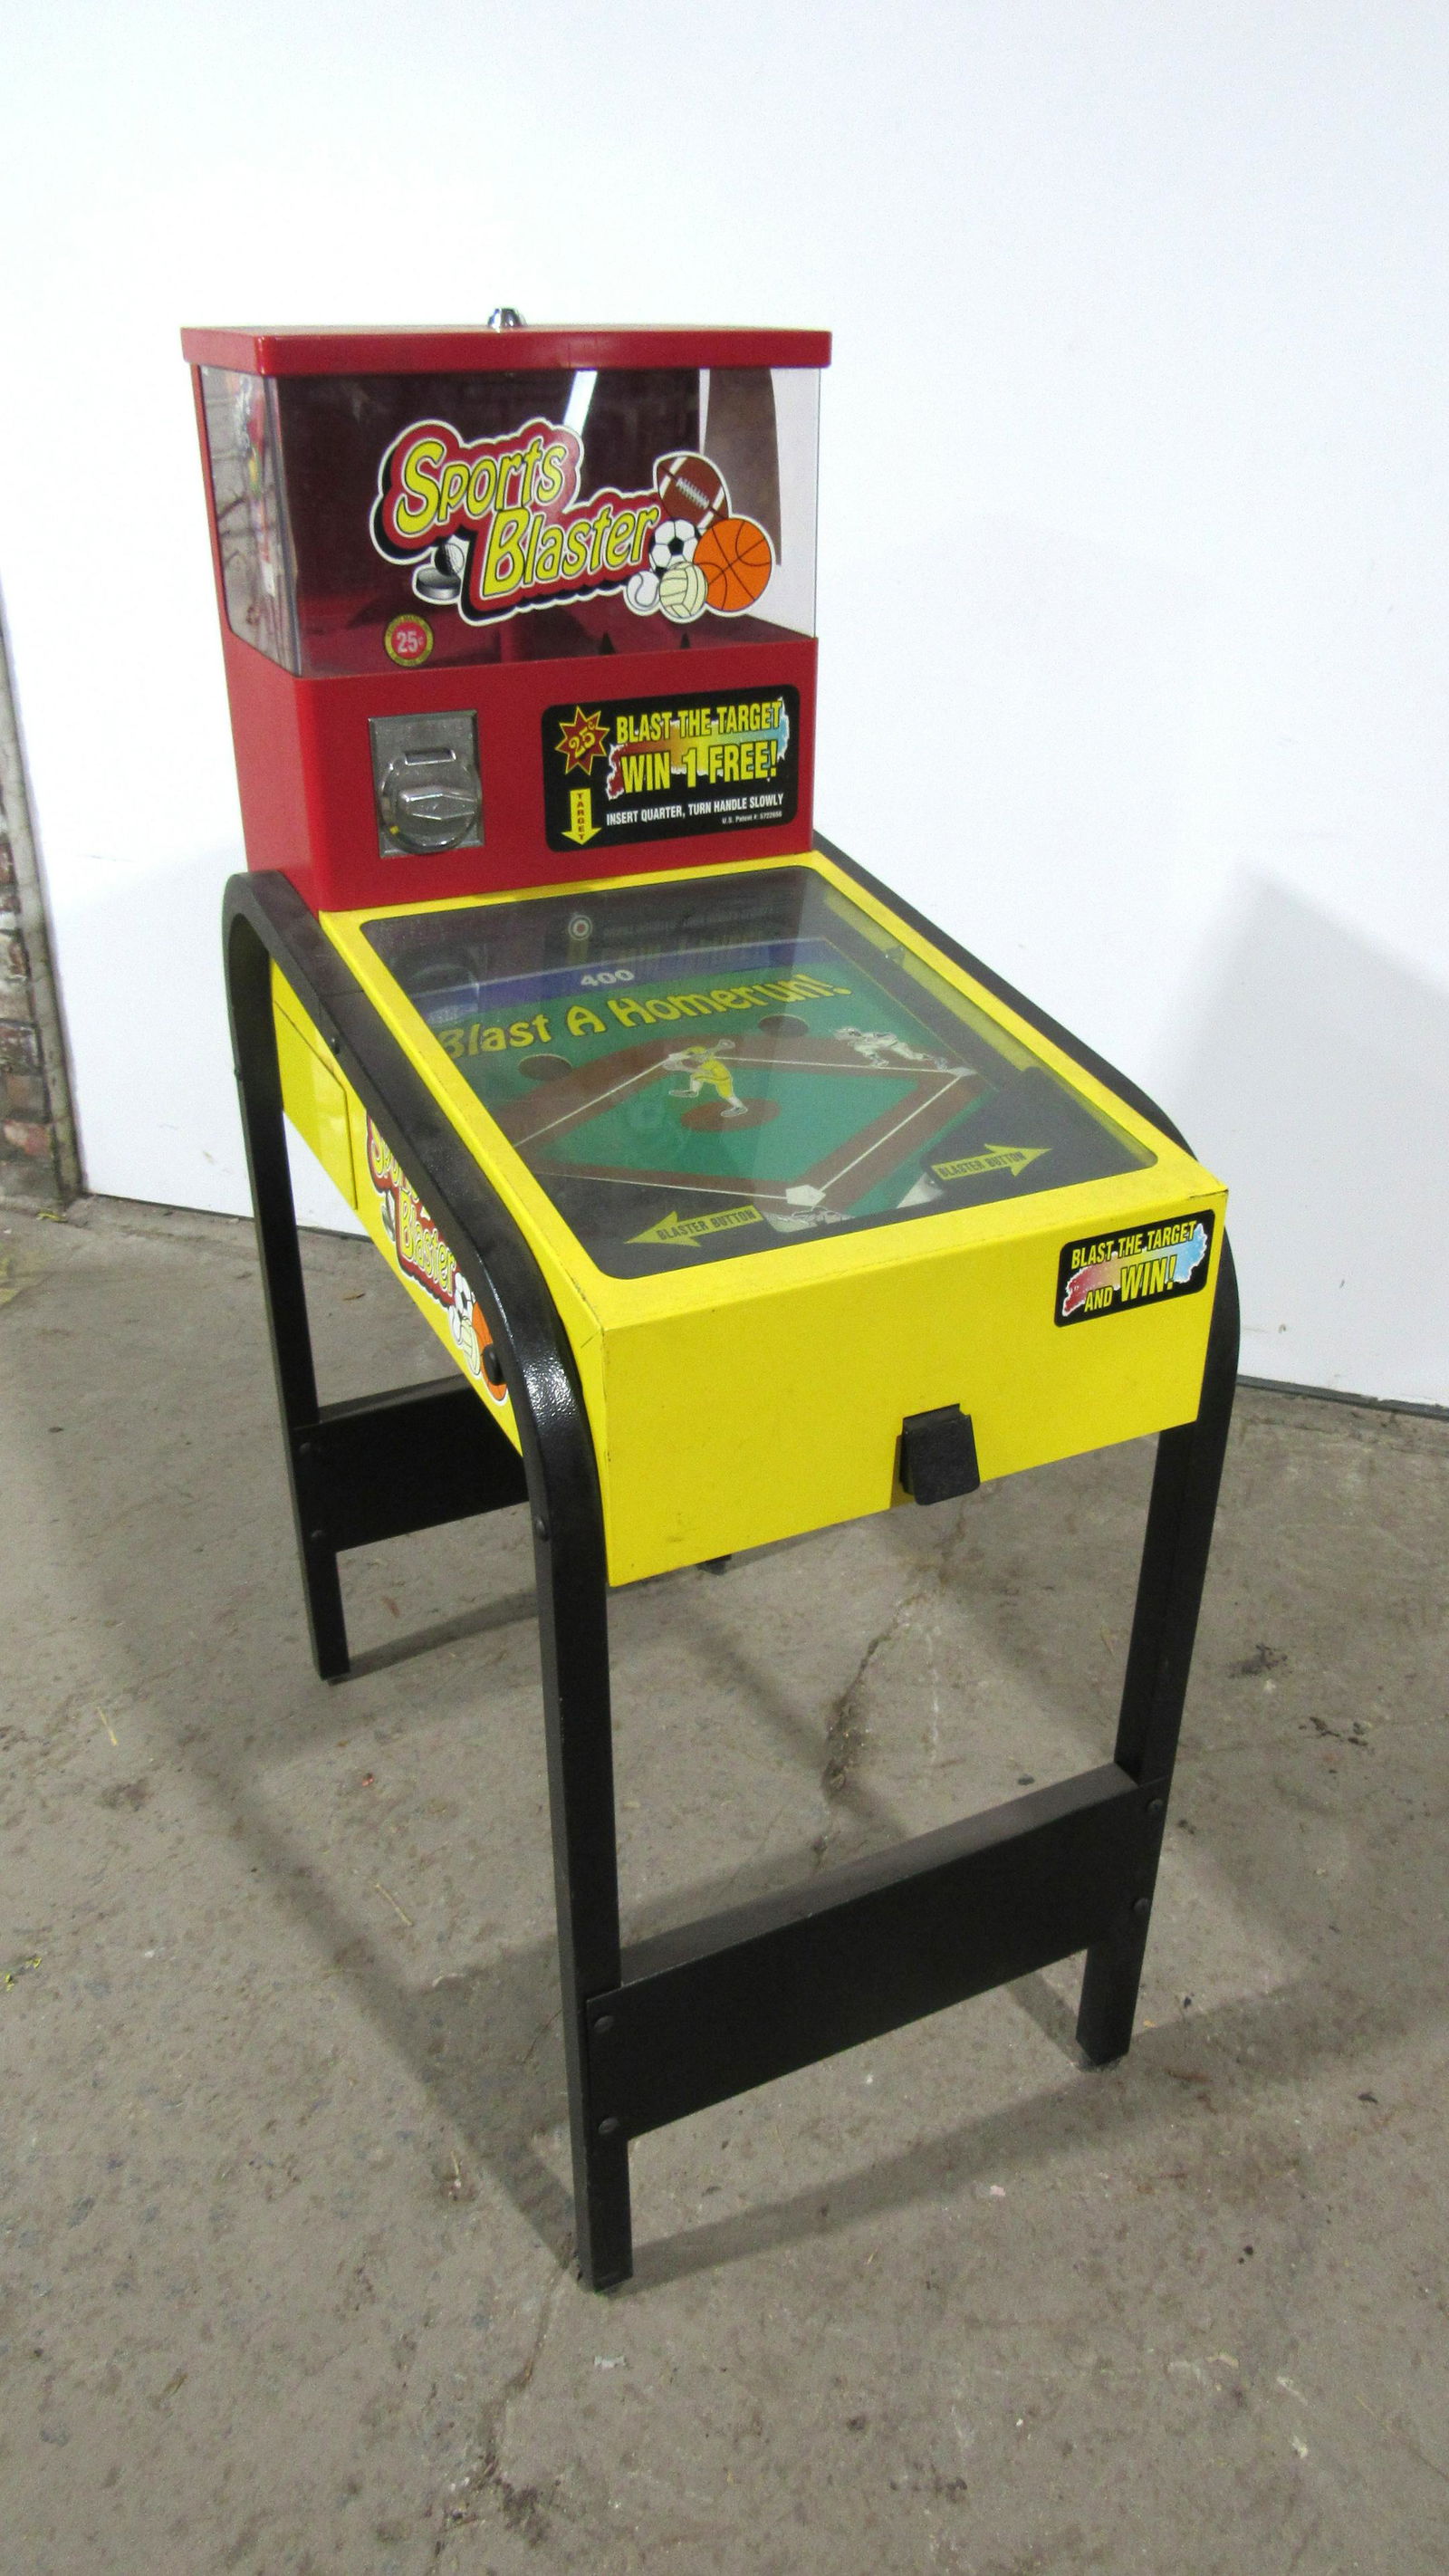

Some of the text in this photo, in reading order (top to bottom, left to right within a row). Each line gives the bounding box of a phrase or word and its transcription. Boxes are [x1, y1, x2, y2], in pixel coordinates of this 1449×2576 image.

[396, 439, 567, 534] Sports
[481, 504, 661, 598] Blaster
[616, 700, 782, 745] BLAST THE TARGET
[621, 740, 778, 794] WIN 1 FREE!
[576, 793, 585, 841] TARGET
[606, 793, 784, 826] INSERT QUARTER, TURN HANDLE SLOWLY
[581, 969, 634, 986] 400
[440, 974, 852, 1059] Blast A Homerun!
[938, 1151, 1027, 1177] BLASTER BUTTON
[399, 1188, 456, 1296] Blaster
[656, 1209, 757, 1240] BLASTER BUTTON
[1071, 1221, 1197, 1269] BLAST THE TARGET
[1084, 1254, 1178, 1312] AND WIN!
